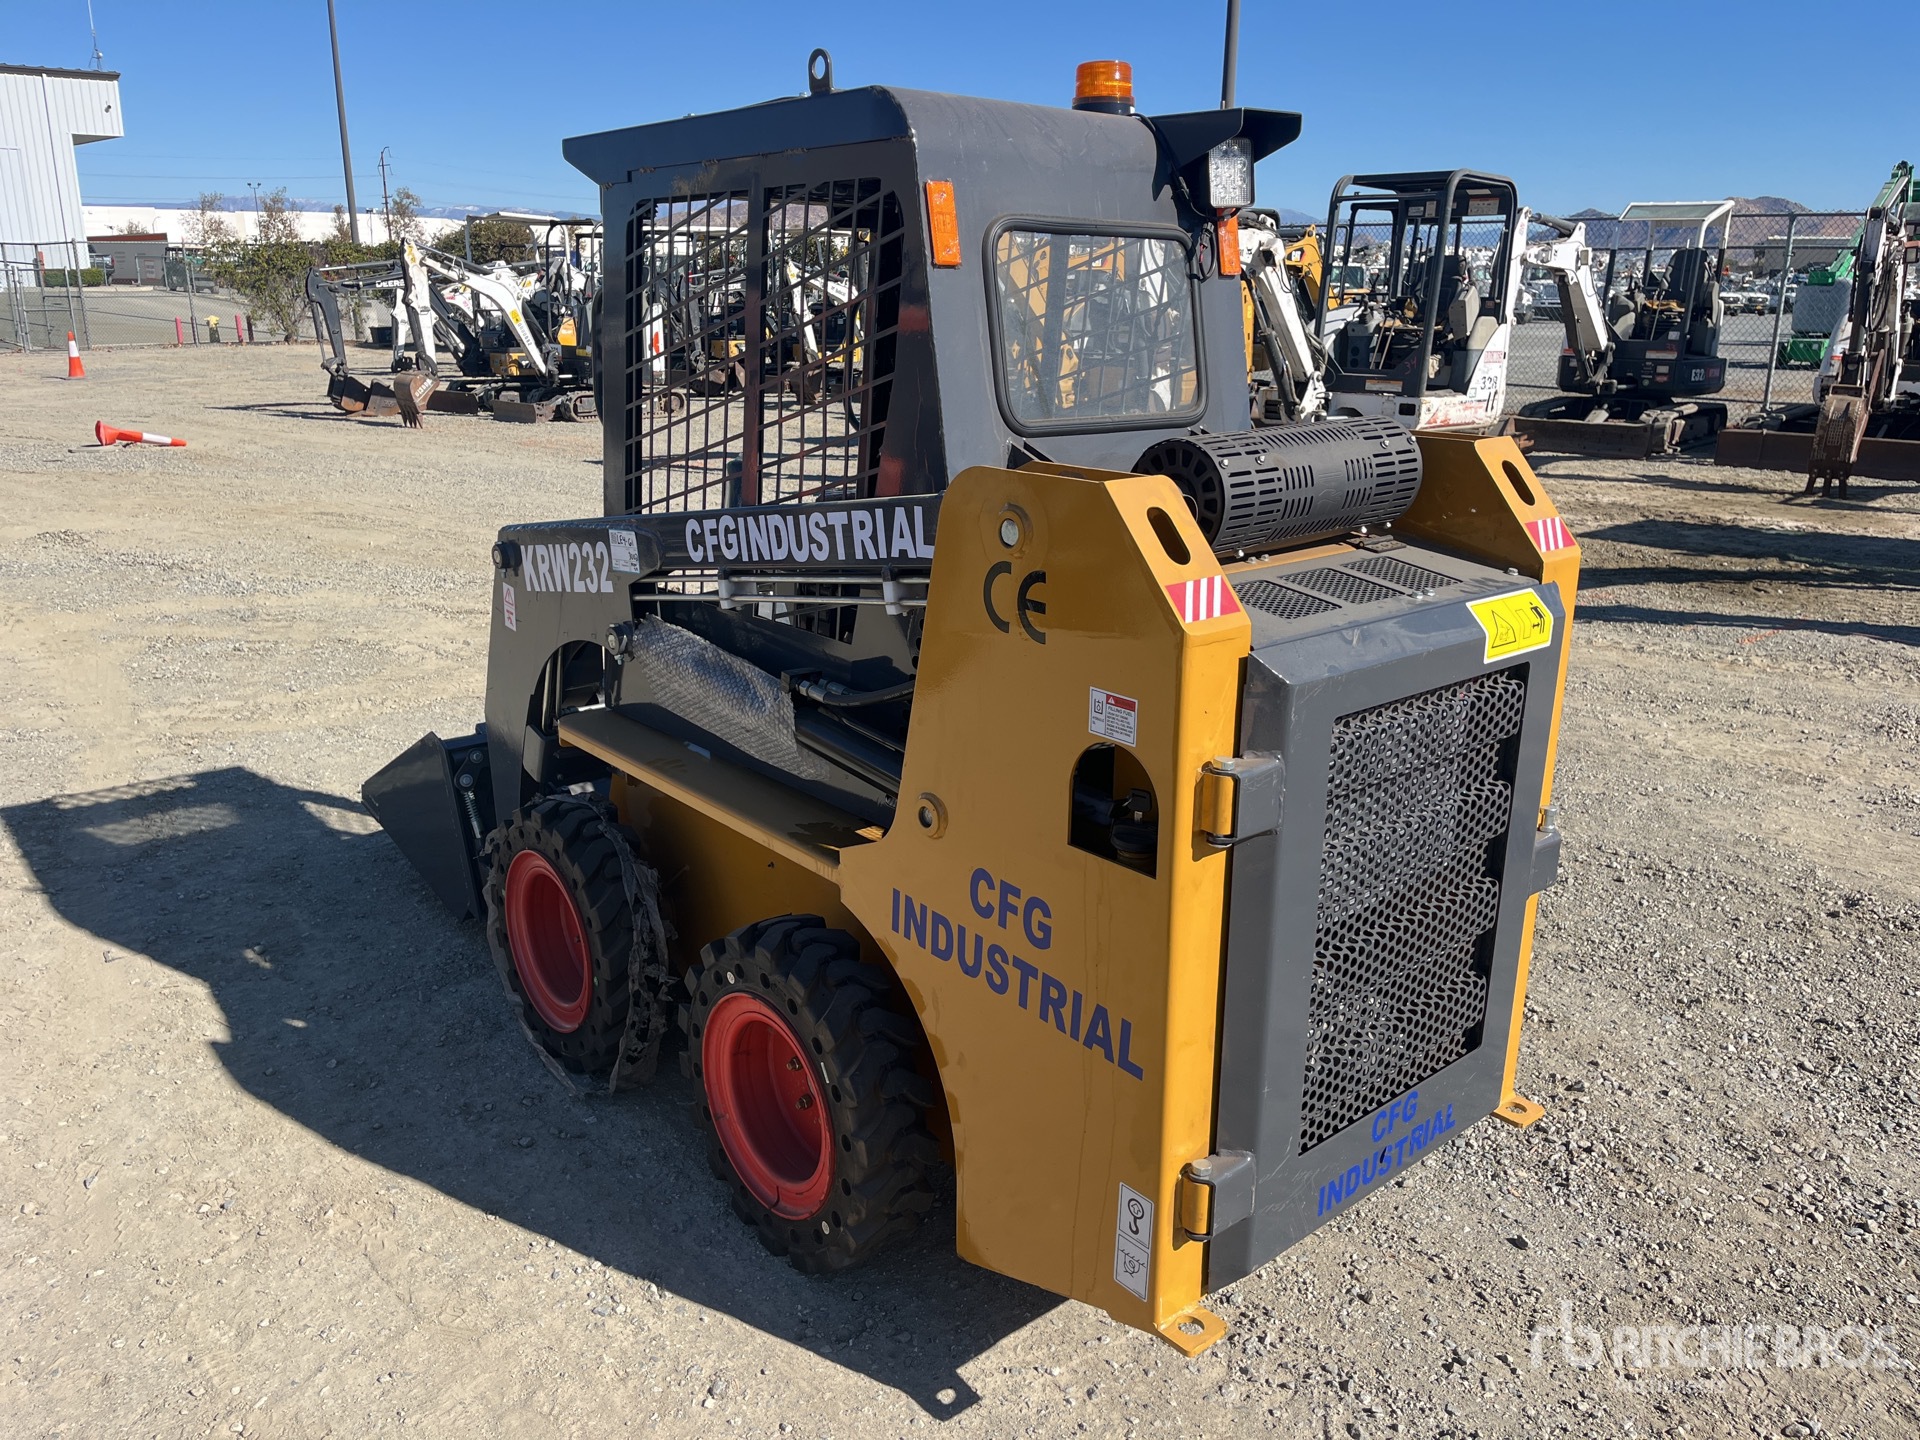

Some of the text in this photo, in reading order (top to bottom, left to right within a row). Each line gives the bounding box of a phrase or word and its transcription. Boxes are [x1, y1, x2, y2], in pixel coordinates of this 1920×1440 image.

[520, 541, 614, 594] KRW232
[969, 867, 1053, 950] CFG
[891, 887, 1144, 1081] INDUSTRIAL
[1371, 1090, 1419, 1143] CFG
[1317, 1103, 1457, 1217] INDUSTRIAL
